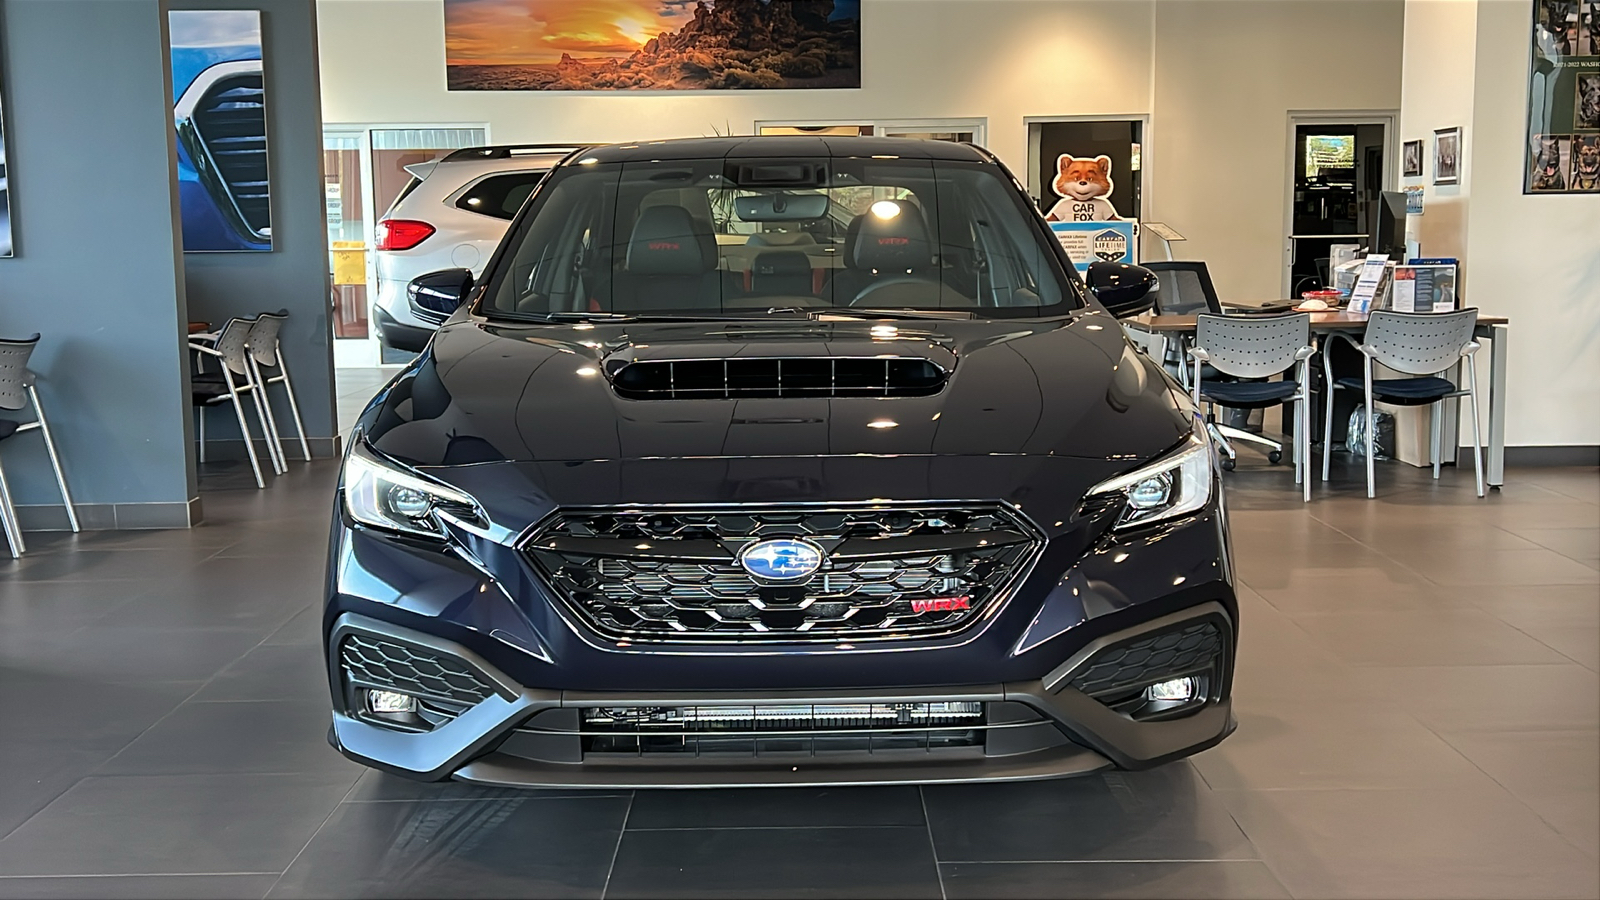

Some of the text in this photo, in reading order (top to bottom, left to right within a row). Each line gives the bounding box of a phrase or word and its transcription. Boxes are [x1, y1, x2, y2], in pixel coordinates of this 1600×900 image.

[1072, 204, 1094, 212] CAR
[1073, 213, 1094, 221] FOX
[910, 596, 970, 613] WRX
